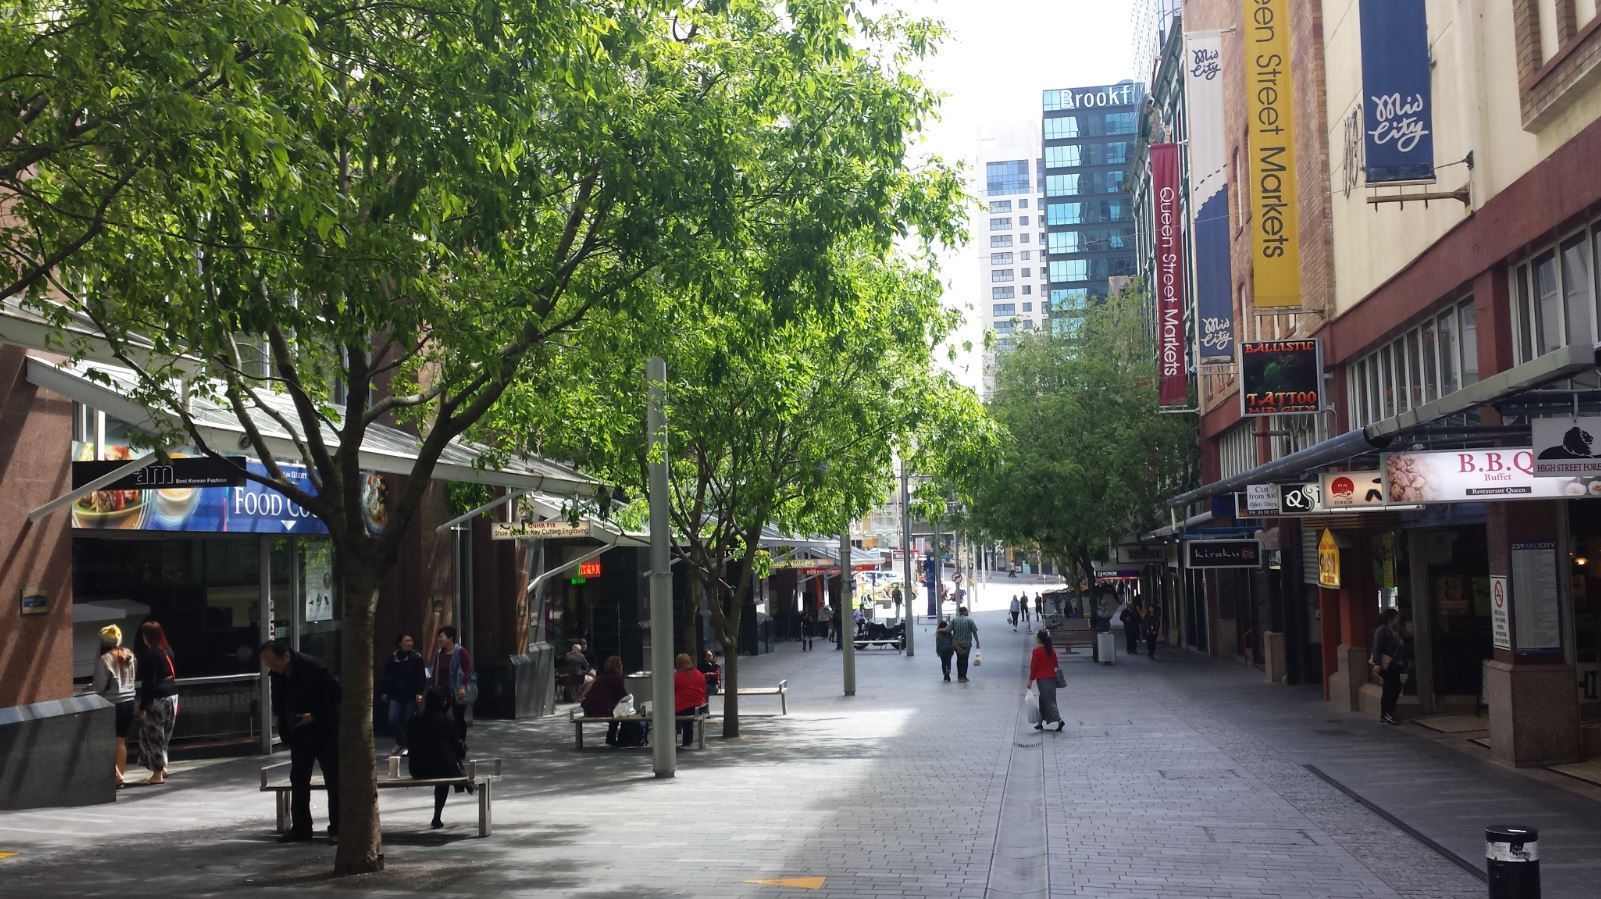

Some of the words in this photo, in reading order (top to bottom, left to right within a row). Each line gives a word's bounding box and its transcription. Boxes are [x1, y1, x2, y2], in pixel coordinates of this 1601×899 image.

[1192, 49, 1219, 64] Mid
[1190, 62, 1221, 80] City
[1256, 54, 1284, 135] Street
[1371, 92, 1424, 122] Mid
[1368, 117, 1430, 152] City
[1260, 146, 1290, 258] Markets
[1159, 187, 1174, 247] Queen
[1162, 253, 1178, 302] Street
[1202, 317, 1230, 334] Mid
[1164, 309, 1180, 376] Markets
[1200, 331, 1233, 350] City
[1244, 341, 1315, 352] BALLISTIC
[1246, 391, 1317, 406] TATTOO
[1484, 473, 1512, 481] Buffet
[1537, 463, 1556, 472] HIGH
[1556, 463, 1583, 472] STREET
[234, 486, 283, 516] FOOD
